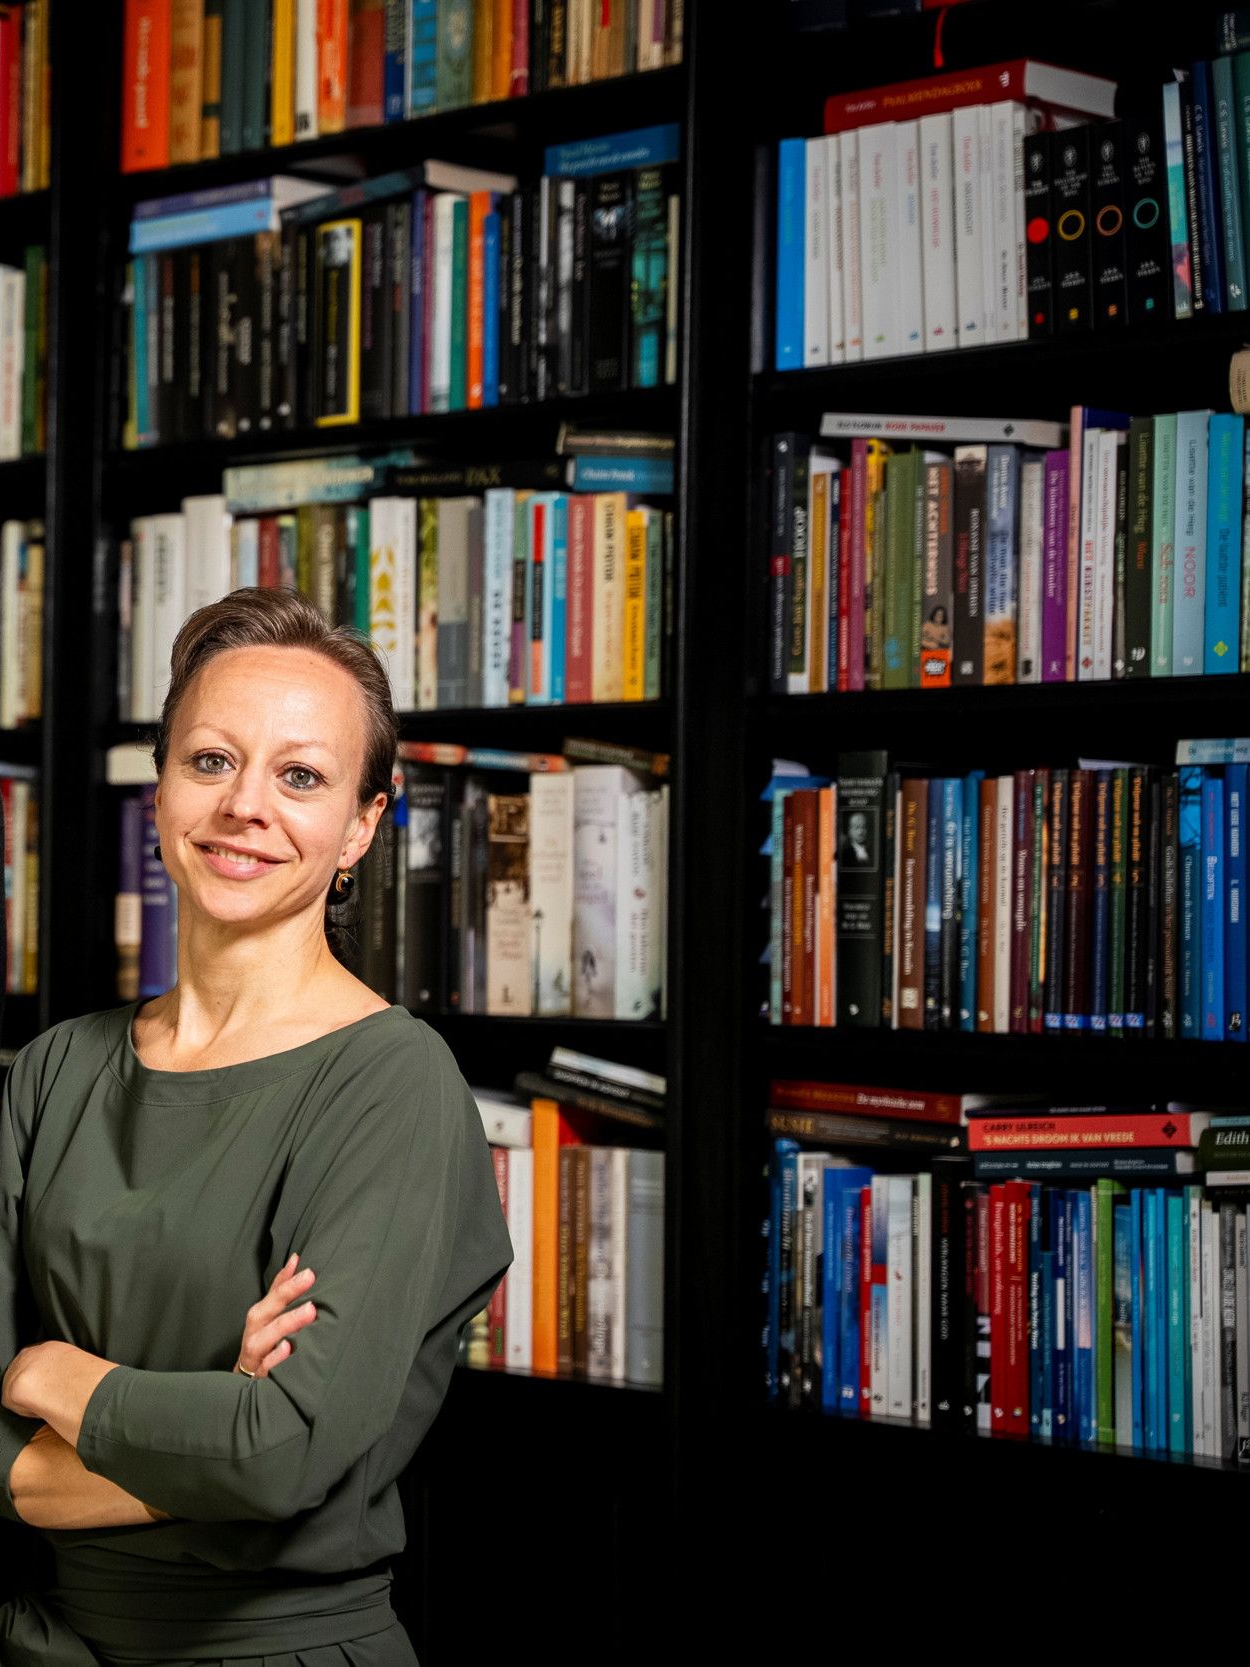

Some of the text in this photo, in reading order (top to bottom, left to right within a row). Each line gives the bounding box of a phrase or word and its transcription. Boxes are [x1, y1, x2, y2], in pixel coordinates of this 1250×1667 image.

[1196, 126, 1205, 153] Lewis
[1221, 122, 1230, 149] Lewis
[1139, 433, 1149, 469] Lisette
[1162, 435, 1170, 471] LISETTE
[465, 467, 501, 485] PAX
[1138, 473, 1147, 491] van
[998, 483, 1007, 509] Avey
[1137, 494, 1147, 508] de
[1162, 494, 1168, 507] DE
[1048, 470, 1057, 560] De kinderen van de
[1134, 510, 1147, 534] Heg
[1184, 440, 1198, 599] Lisette van de Heg NOOR
[605, 503, 615, 582] CHAIM POTOK
[793, 506, 806, 558] HOOP
[925, 468, 939, 597] HET ACHTERHUIS
[1160, 543, 1172, 570] Sub
[1217, 528, 1231, 607] De laatste patiënt
[629, 567, 640, 600] POTOK
[988, 531, 999, 615] Auschwitz wilde
[998, 531, 1009, 614] De man die naar
[1158, 573, 1169, 604] rosa
[906, 829, 915, 852] Boer
[905, 859, 916, 878] Een
[941, 821, 956, 919] Er is verwachting
[1165, 846, 1173, 867] Gods
[1184, 856, 1192, 887] Christus
[1014, 849, 1027, 932] Vrees en vreugde
[1164, 869, 1173, 904] beloften
[1206, 856, 1218, 900] BELOFTEN
[903, 880, 915, 931] vreemdeling
[1184, 910, 1192, 940] christen
[904, 944, 913, 975] Kanaän
[960, 961, 969, 981] Boer
[770, 1114, 815, 1134] SUSIE
[983, 1132, 1134, 1145] 'S NACHTS DROOM IK VAN VREDE
[984, 1122, 1055, 1132] CARRY ULREICH
[1215, 1130, 1249, 1146] Edith
[940, 1238, 949, 1290] VERLANGEN
